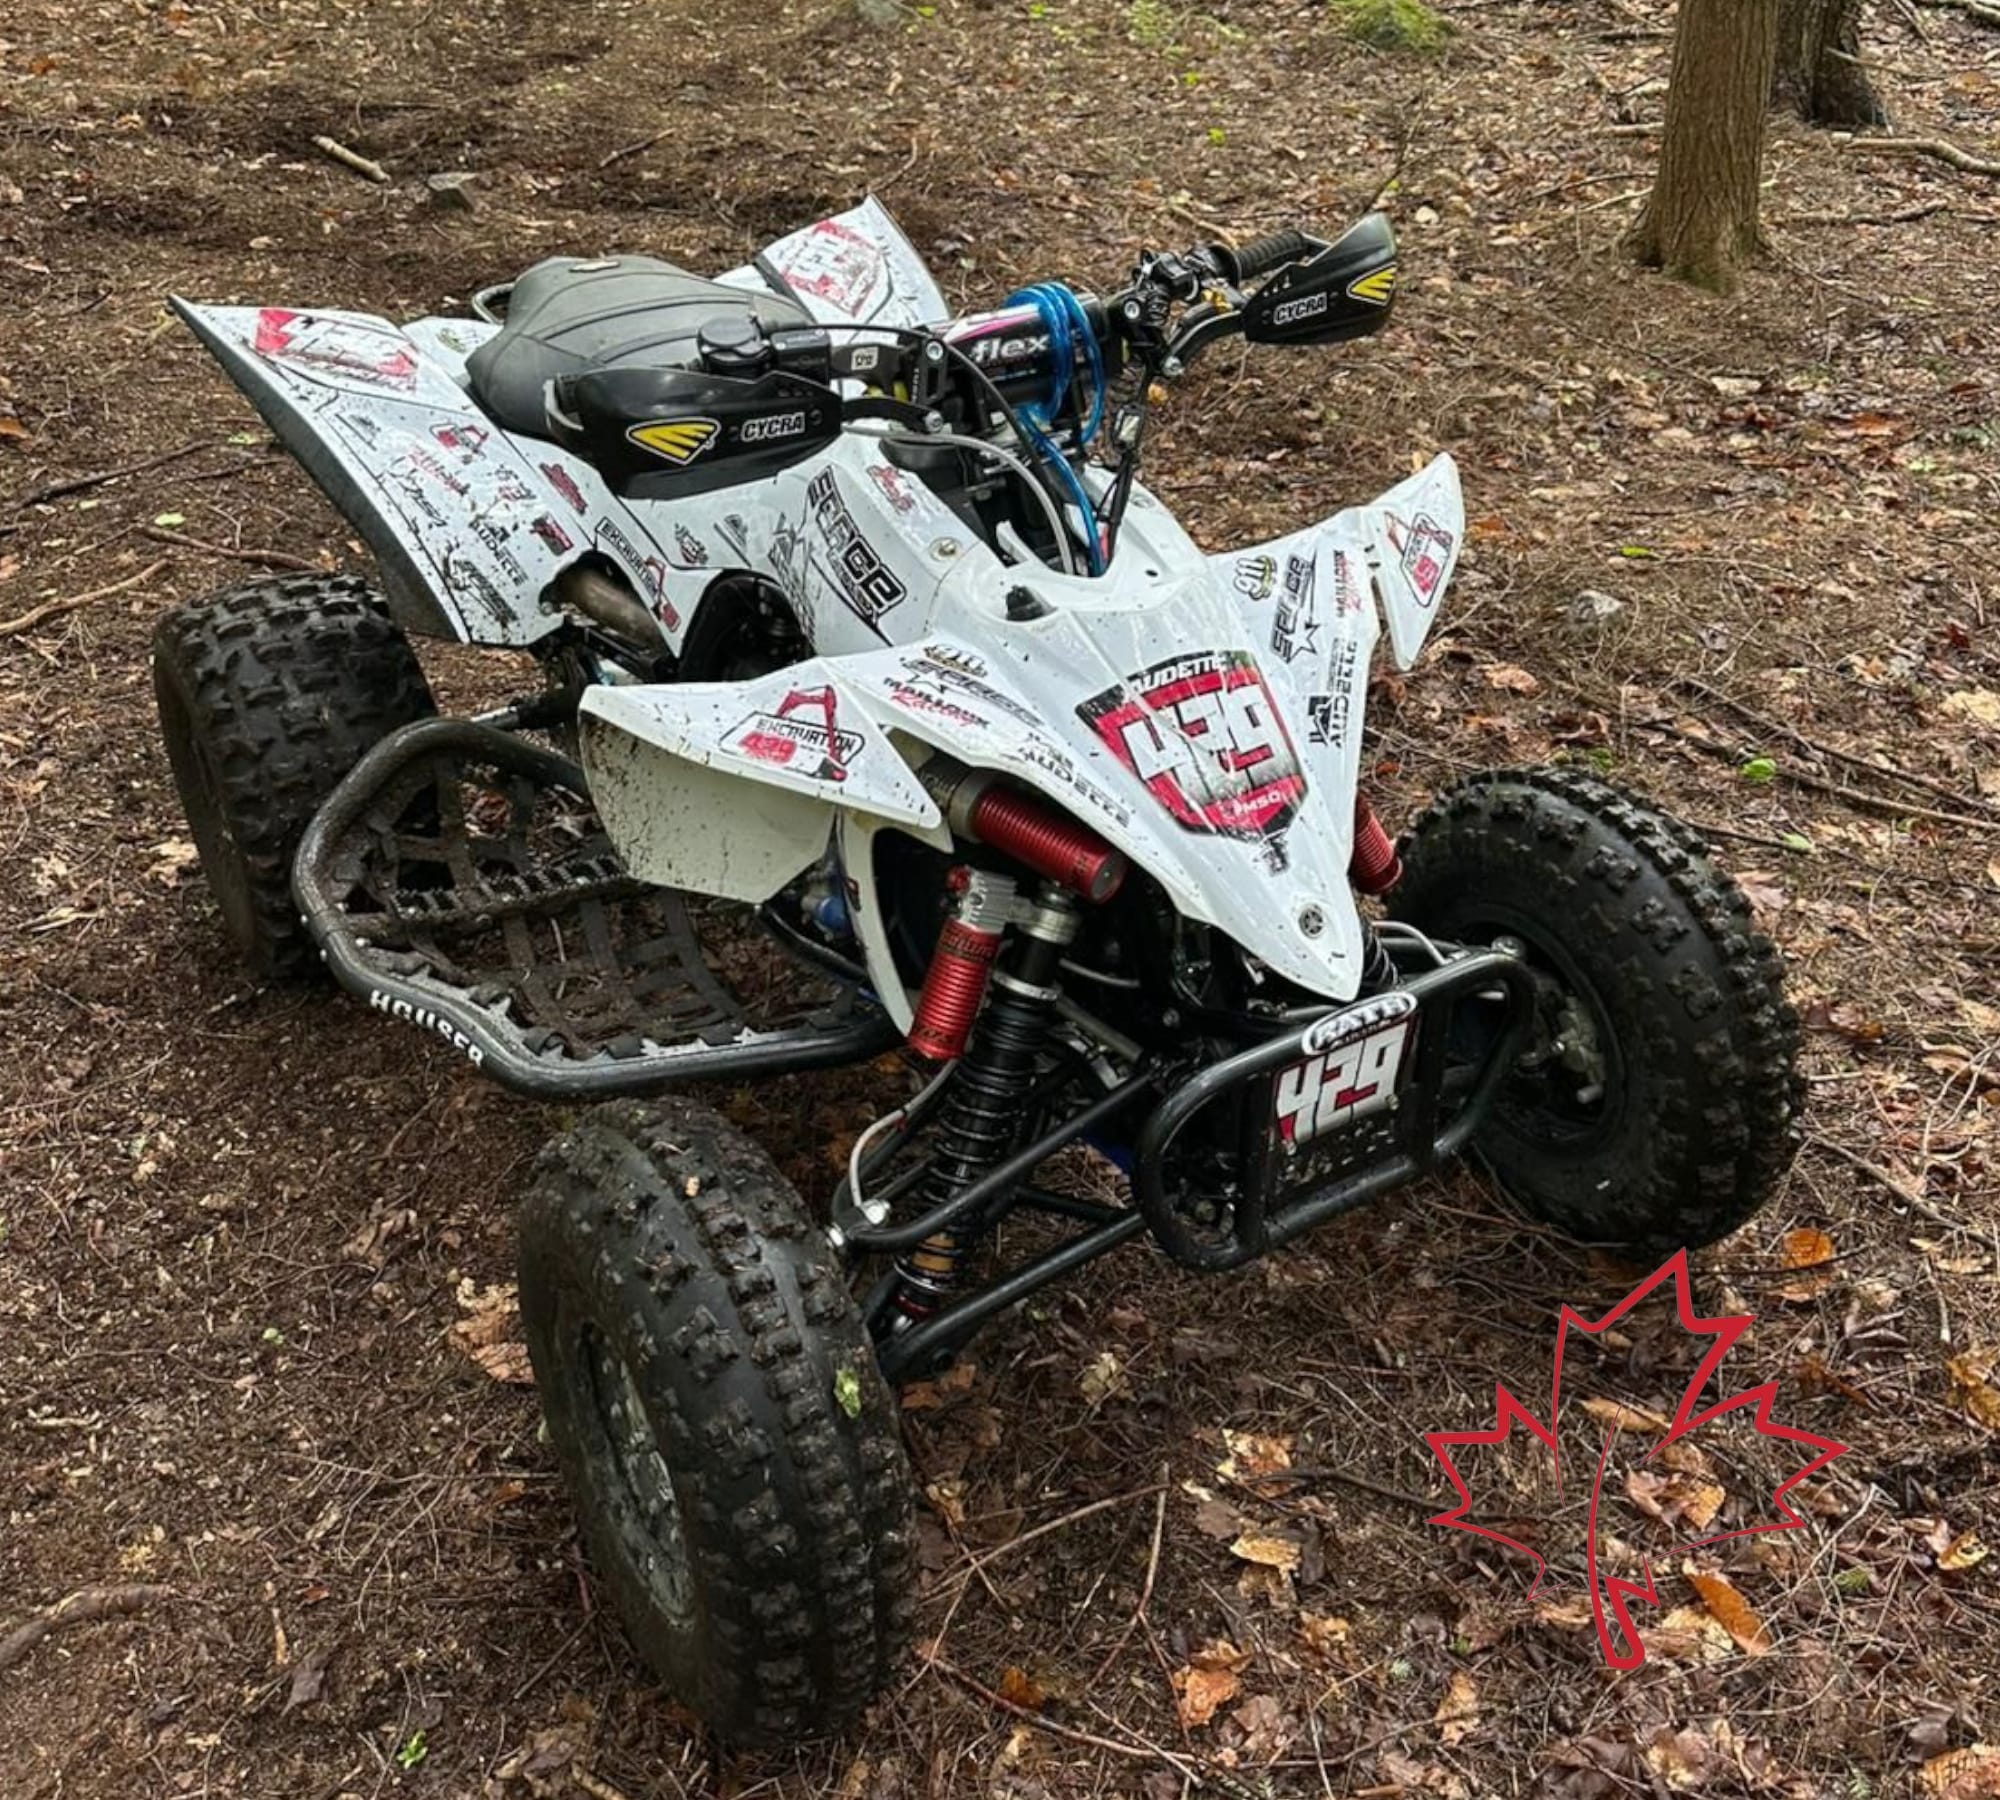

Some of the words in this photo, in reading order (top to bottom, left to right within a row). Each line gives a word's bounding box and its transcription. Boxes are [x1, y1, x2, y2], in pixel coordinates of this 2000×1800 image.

[1274, 292, 1328, 325] CYCRA
[741, 412, 805, 442] CYCRA
[1121, 685, 1298, 810] 429
[1277, 1020, 1409, 1146] 429
